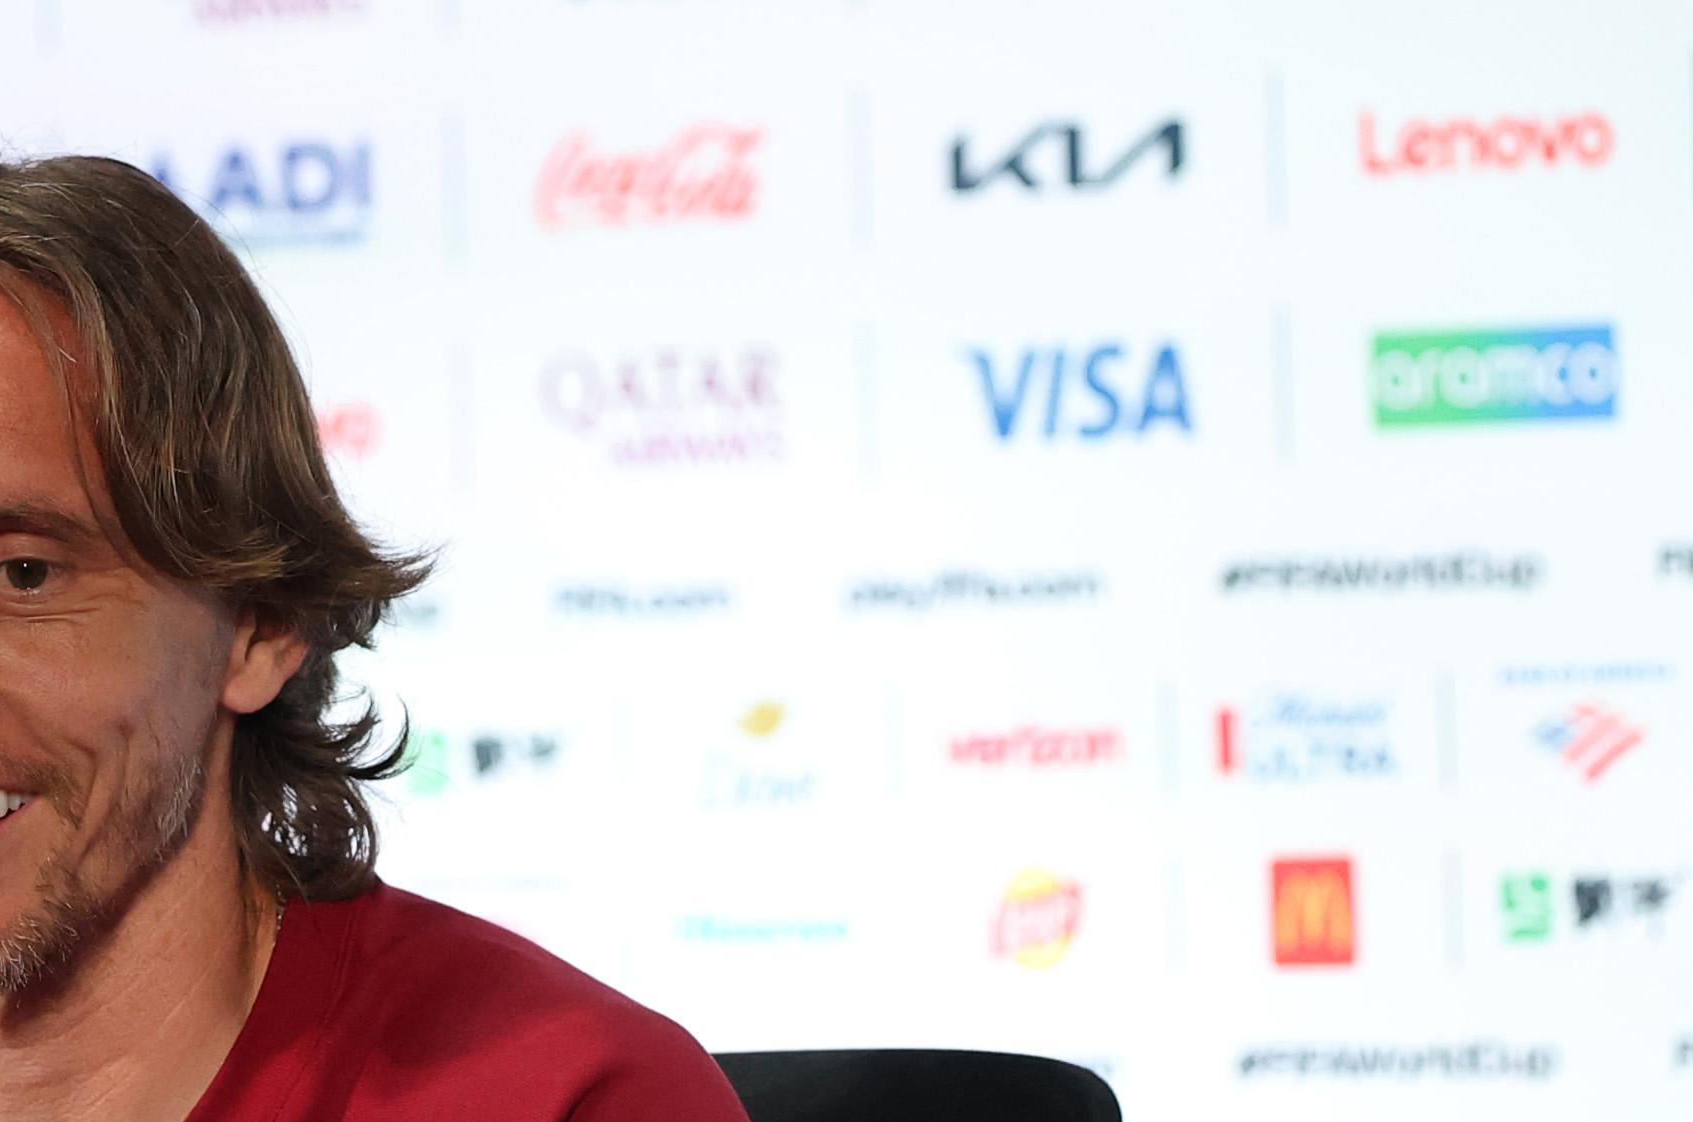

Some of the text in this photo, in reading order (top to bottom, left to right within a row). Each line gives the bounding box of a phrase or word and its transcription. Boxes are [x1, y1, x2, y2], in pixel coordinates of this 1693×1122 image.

[209, 141, 371, 212] ADI
[948, 118, 1186, 194] KIA
[1360, 112, 1614, 176] Lenovo
[968, 341, 1195, 441] VISA
[1373, 345, 1614, 410] aramco
[949, 725, 1120, 766] verizon
